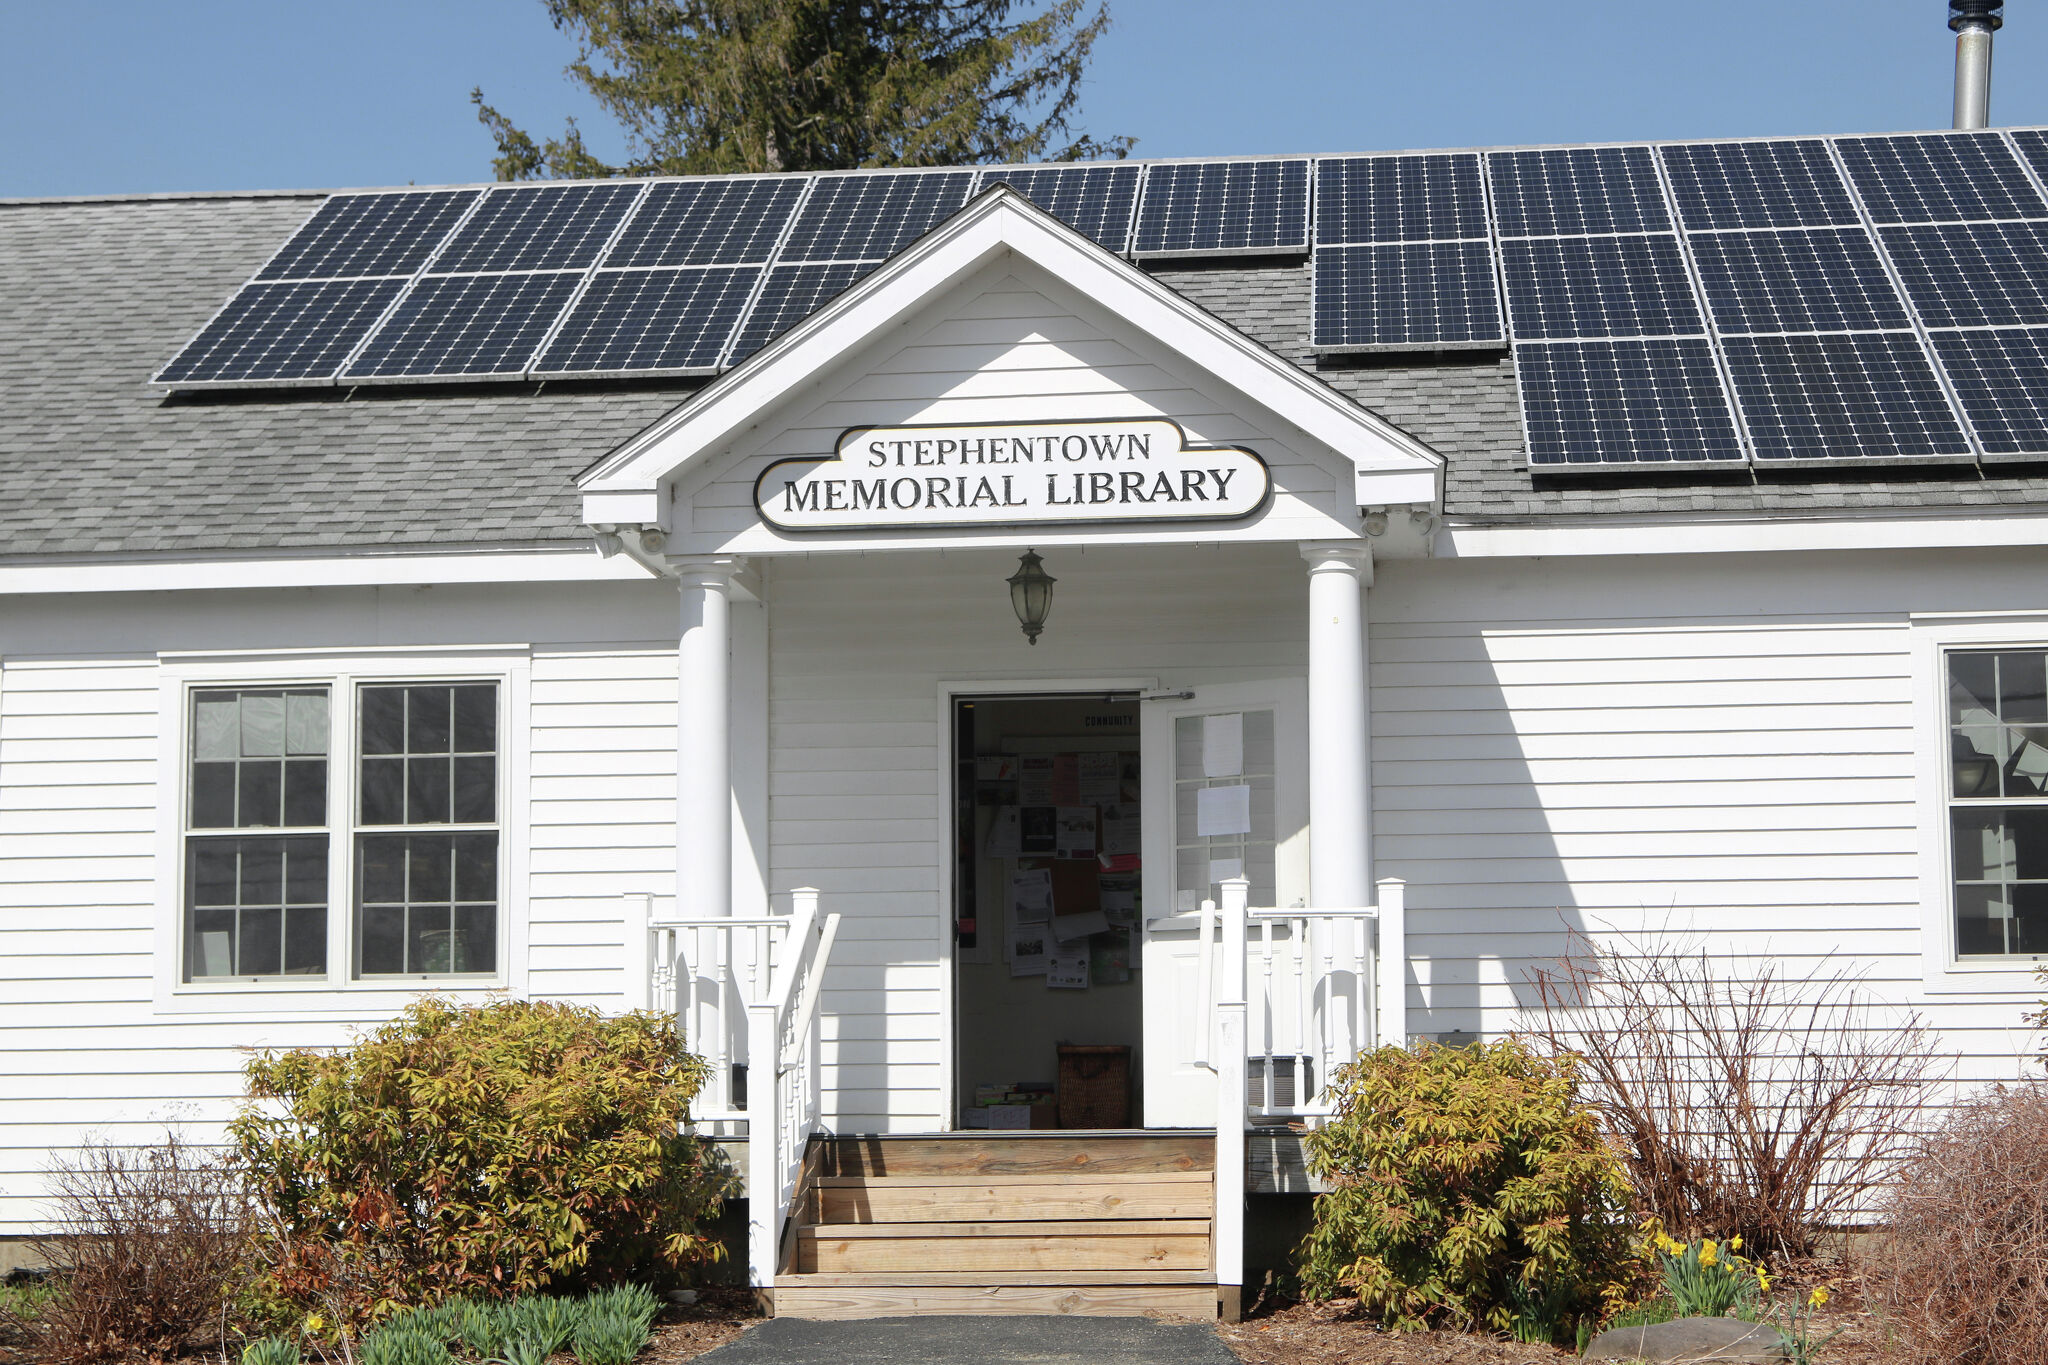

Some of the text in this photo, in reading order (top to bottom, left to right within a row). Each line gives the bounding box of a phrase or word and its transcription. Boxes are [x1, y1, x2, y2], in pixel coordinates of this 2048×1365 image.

[868, 433, 1151, 468] STEPHENTOWN
[783, 468, 1237, 512] MEMORIAL LIBRARY
[1084, 714, 1134, 728] COMMUNITY
